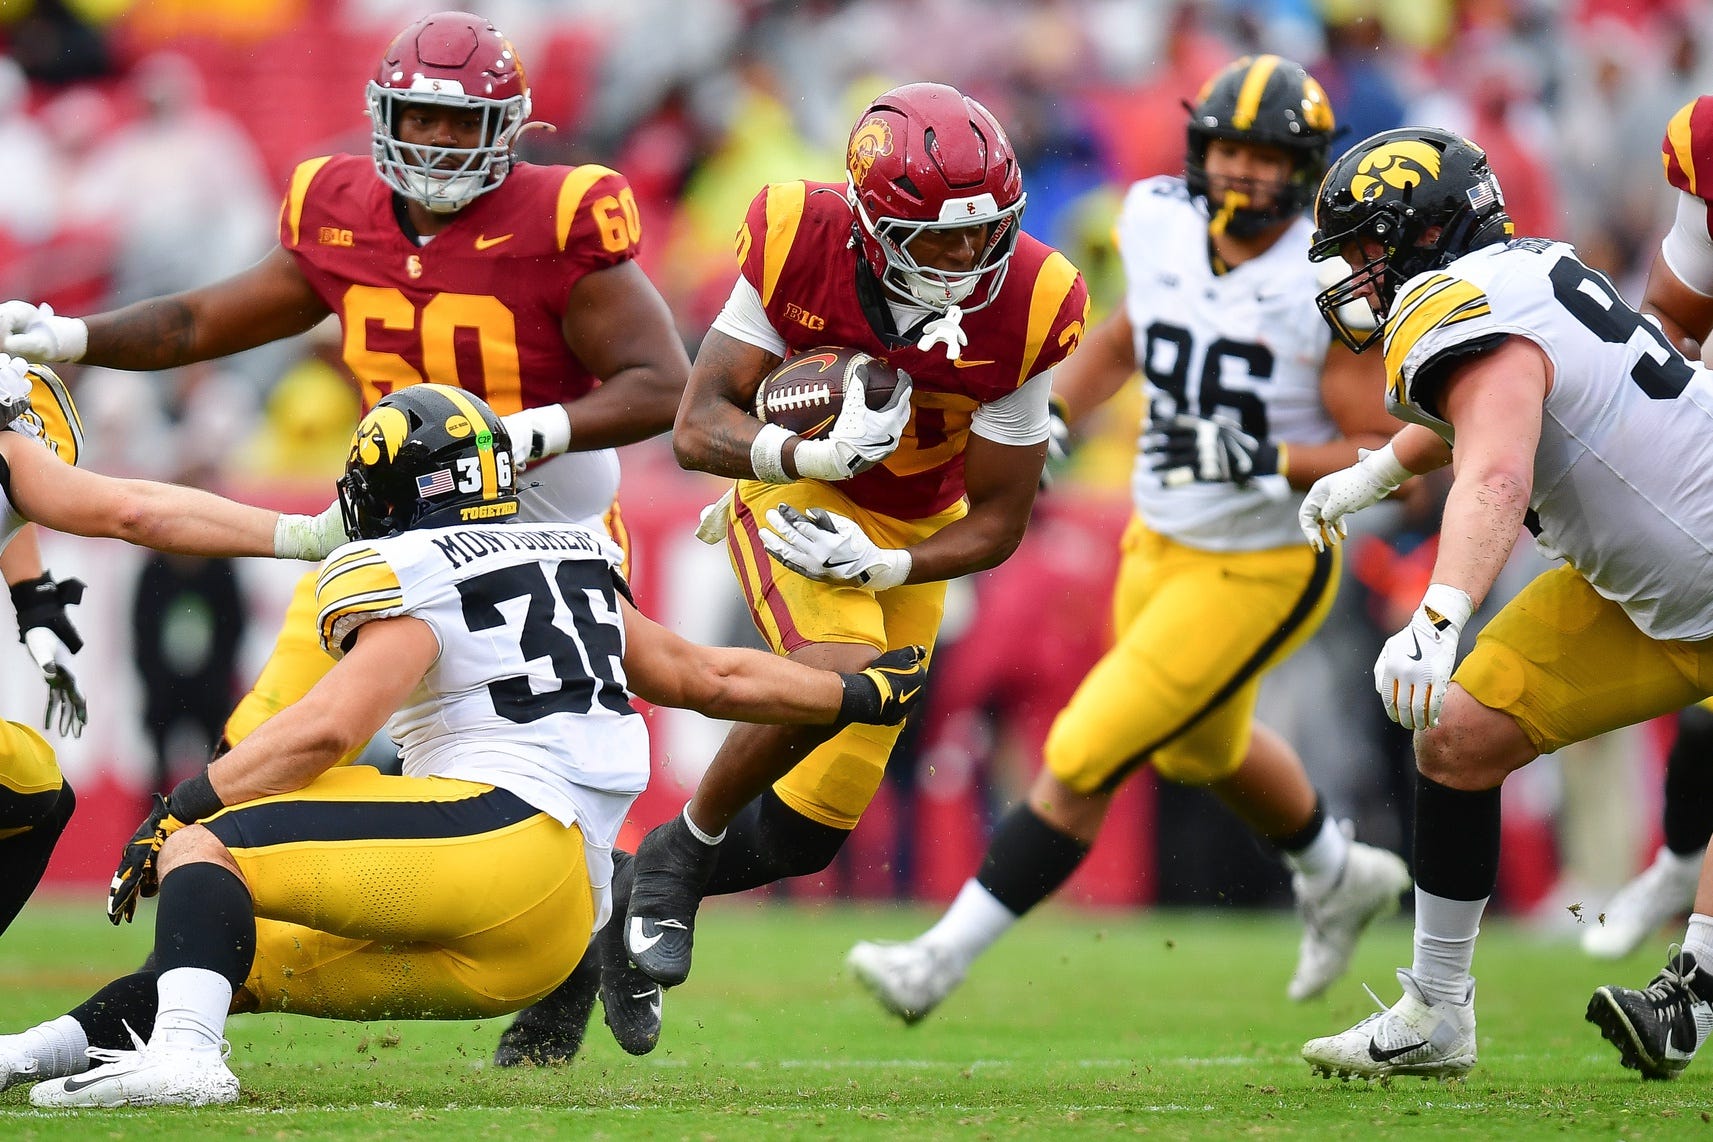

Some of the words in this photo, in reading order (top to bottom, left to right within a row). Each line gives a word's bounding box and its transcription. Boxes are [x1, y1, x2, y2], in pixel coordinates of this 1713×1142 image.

[592, 187, 642, 253] 60
[342, 284, 523, 416] 60
[1144, 321, 1275, 448] 96
[478, 435, 492, 444] C2P
[460, 501, 517, 521] TOGETHER
[455, 558, 637, 723] 36
